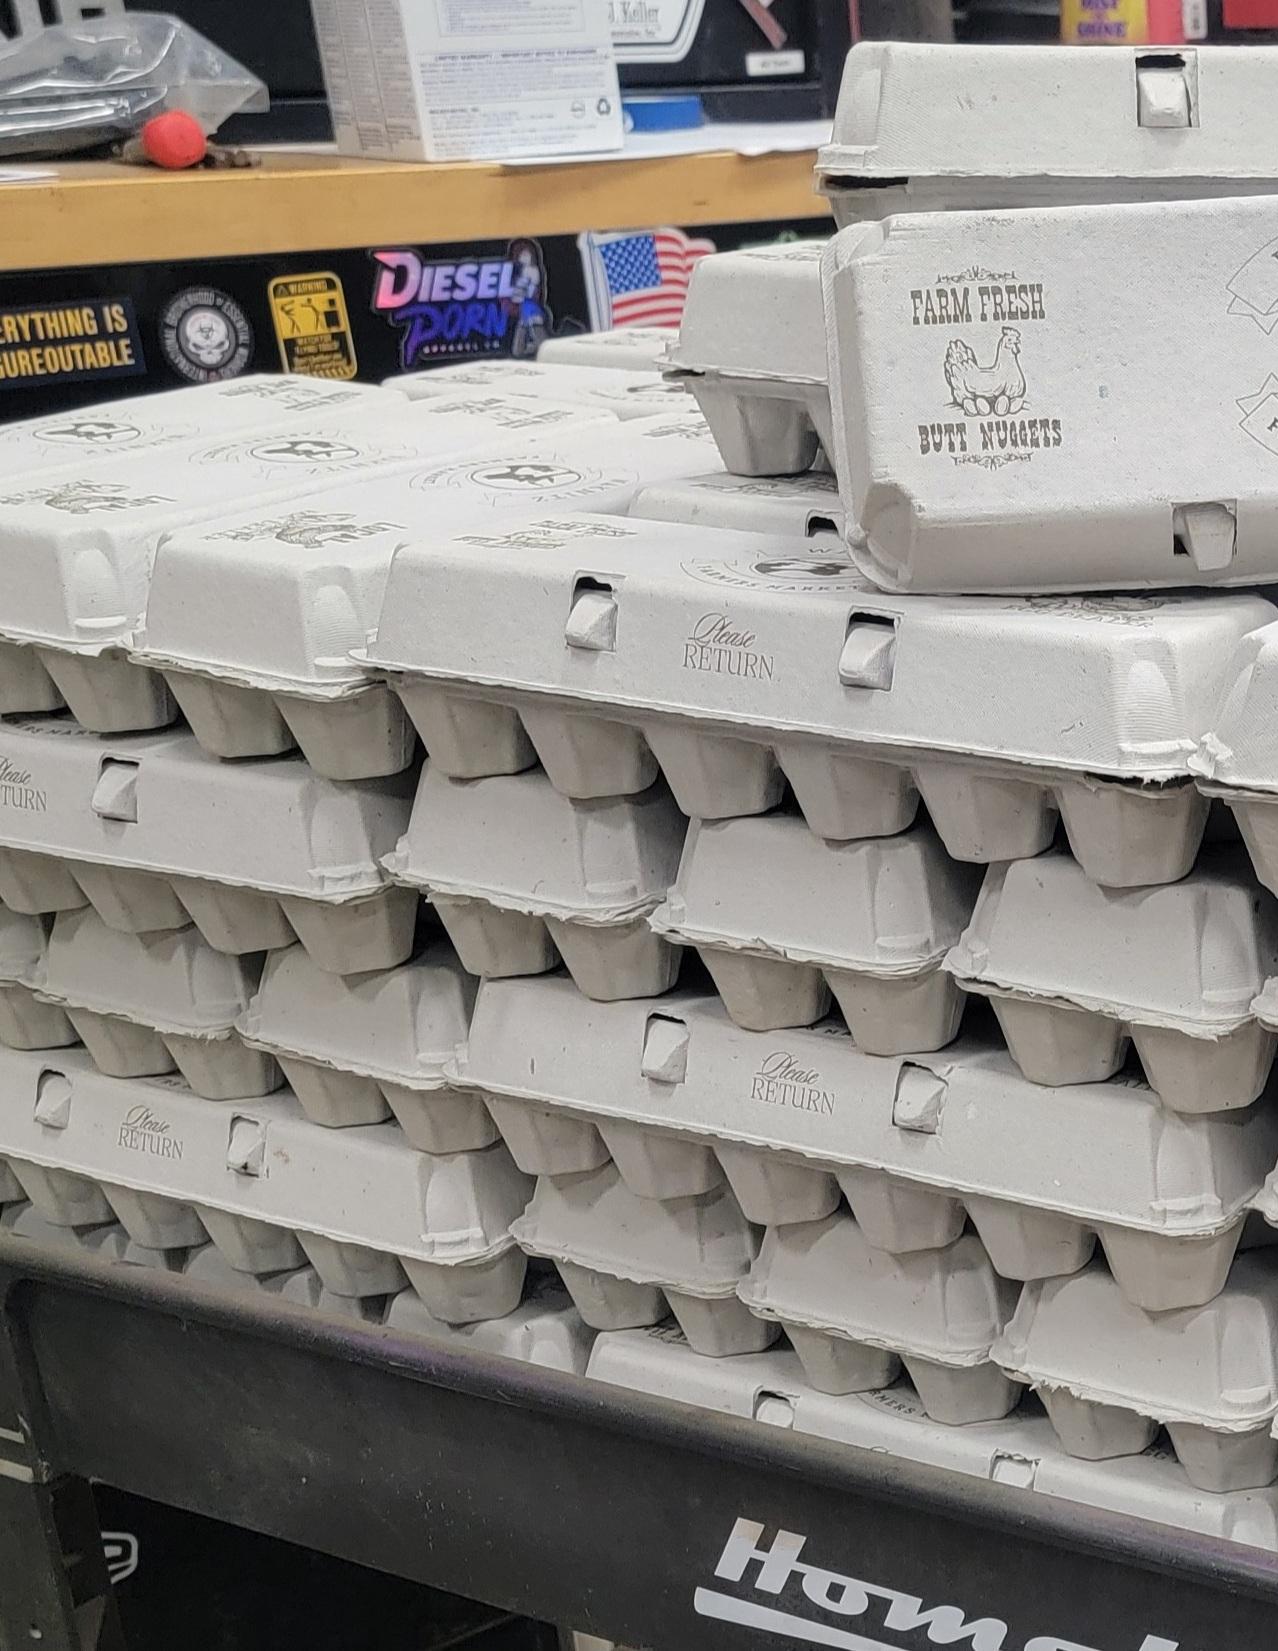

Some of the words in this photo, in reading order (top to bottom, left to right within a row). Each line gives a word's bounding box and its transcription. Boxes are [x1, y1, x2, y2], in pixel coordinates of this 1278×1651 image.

[373, 251, 514, 309] DIESEL
[103, 303, 128, 333] IS
[910, 286, 972, 326] FARM
[978, 283, 1046, 322] FRESH
[395, 303, 507, 365] PORN
[918, 422, 968, 455] BUTT
[980, 418, 1063, 451] NUGGETS
[687, 612, 758, 648] Please
[682, 642, 775, 681] RETURN
[756, 1051, 820, 1085] Please
[751, 1077, 835, 1115] RETURN
[122, 1104, 170, 1133] Please
[118, 1126, 183, 1160] RETURN
[713, 1517, 1180, 1651] Hom
